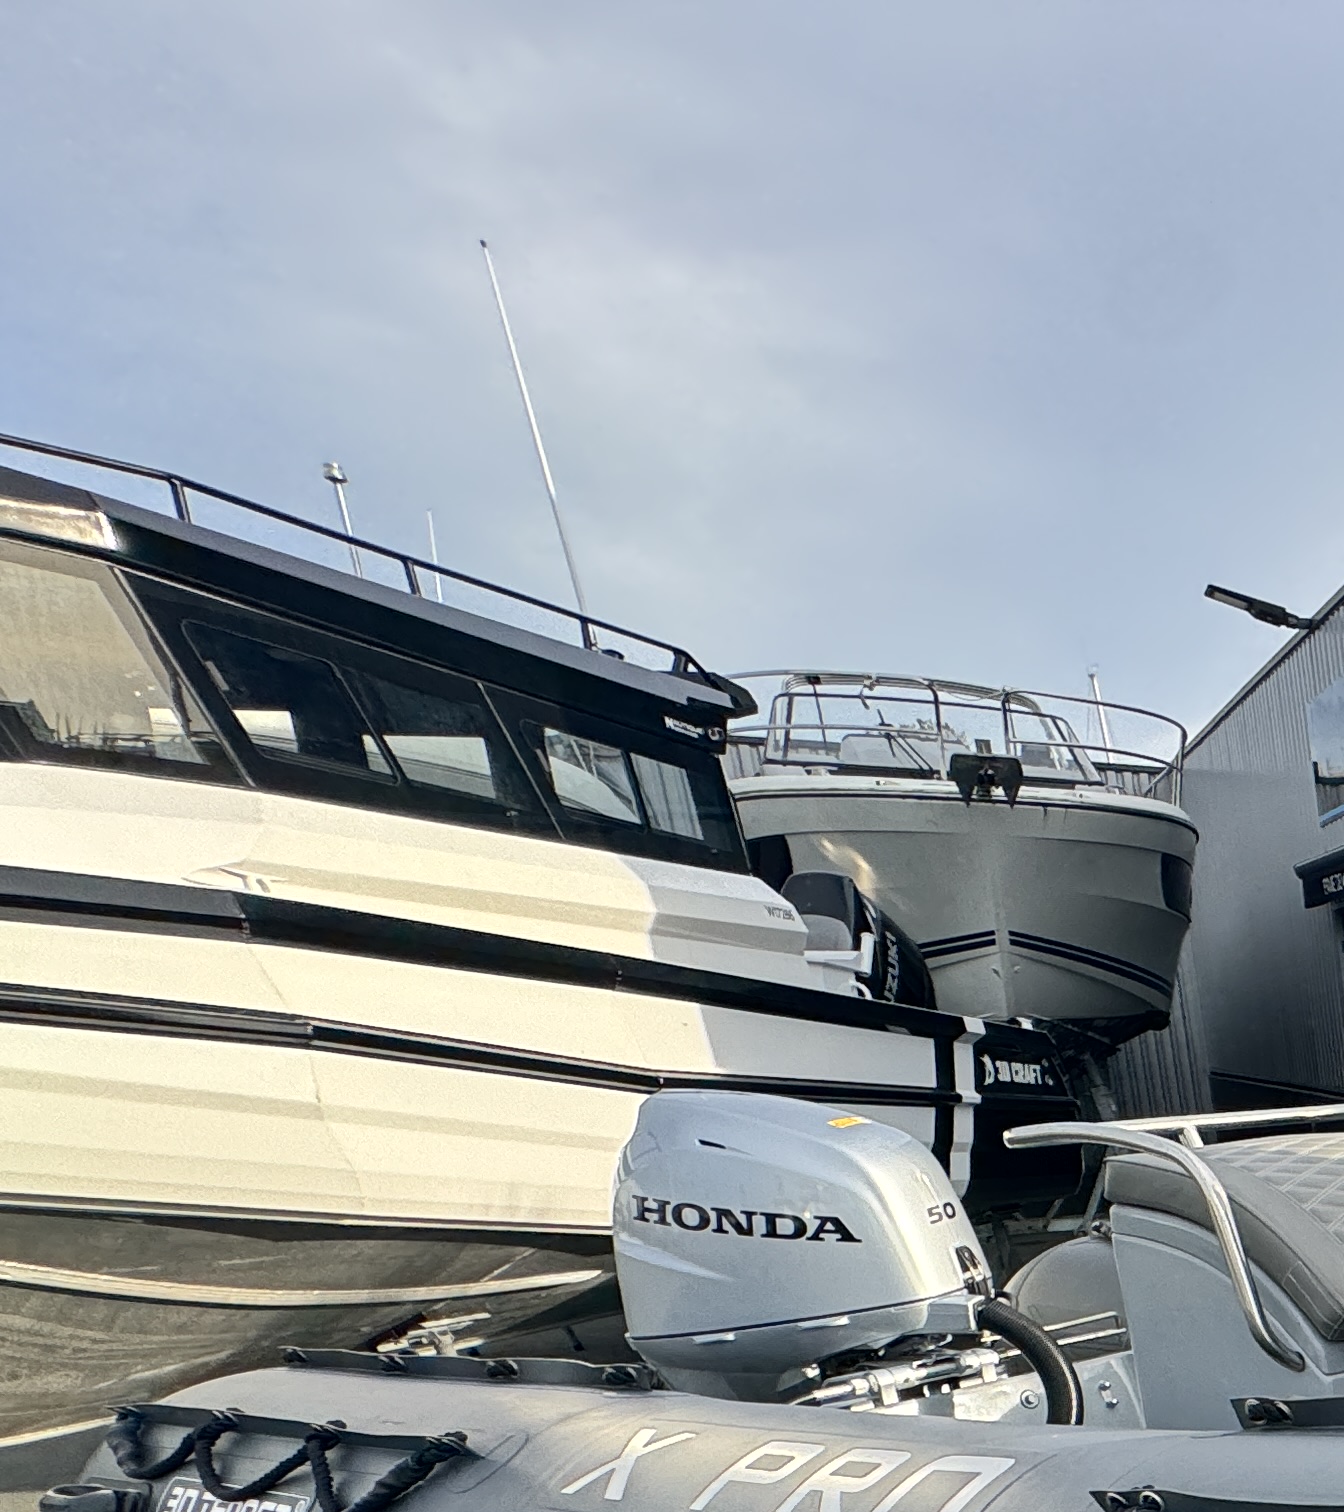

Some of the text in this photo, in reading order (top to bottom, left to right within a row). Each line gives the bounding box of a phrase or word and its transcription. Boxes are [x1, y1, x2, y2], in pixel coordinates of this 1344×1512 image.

[631, 1194, 863, 1244] HONDA
[926, 1201, 957, 1225] 50
[560, 1427, 699, 1501] X
